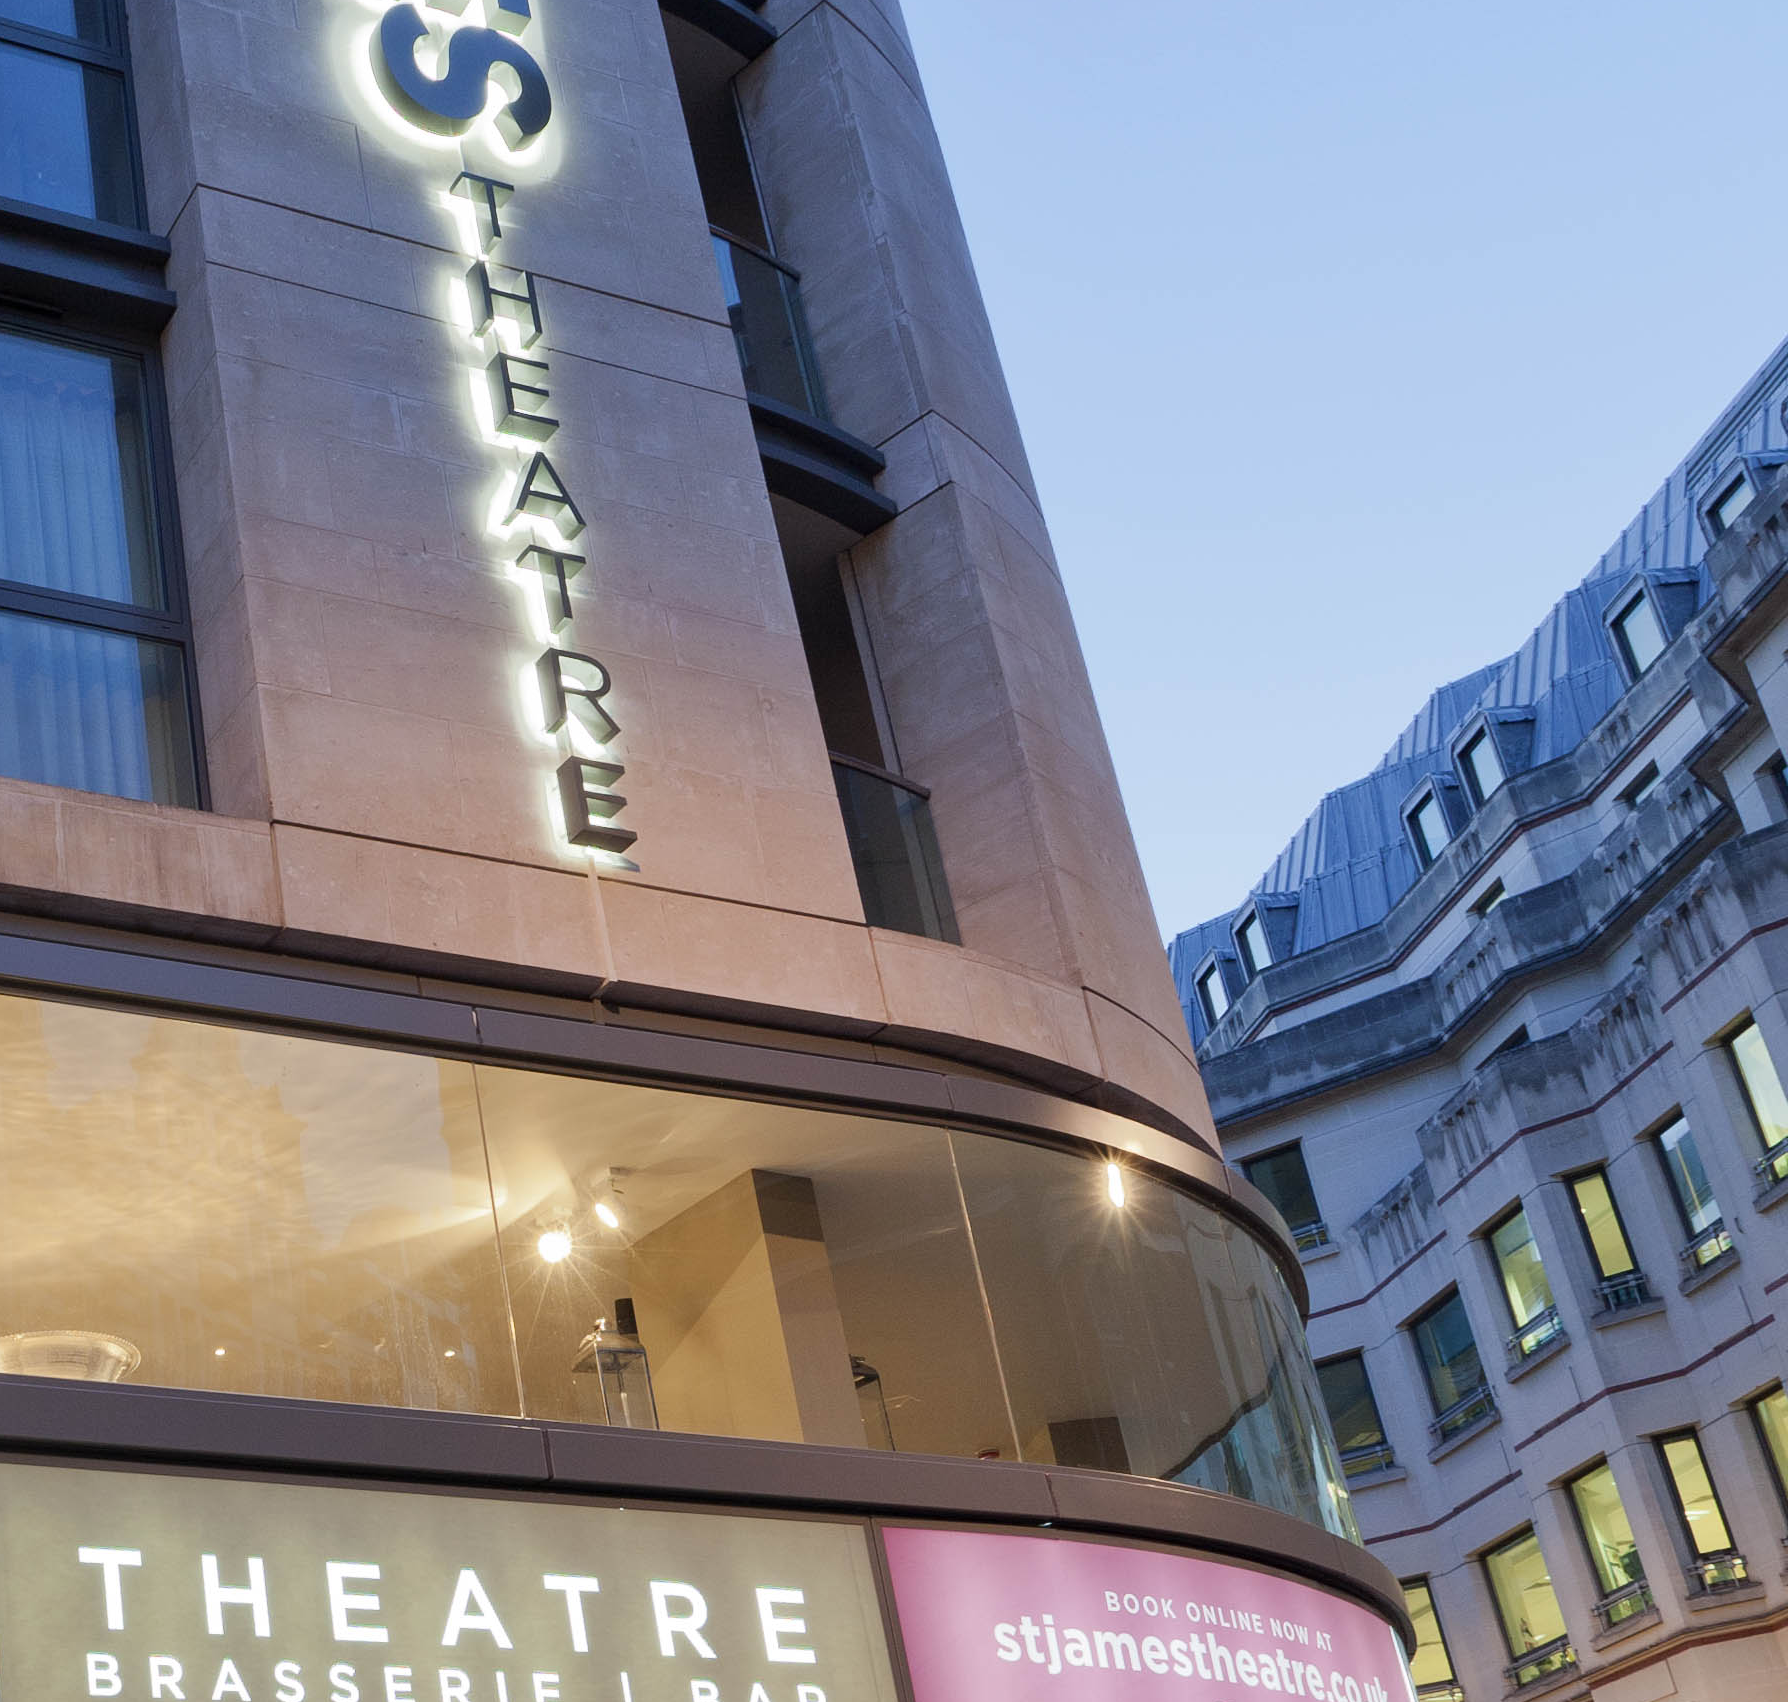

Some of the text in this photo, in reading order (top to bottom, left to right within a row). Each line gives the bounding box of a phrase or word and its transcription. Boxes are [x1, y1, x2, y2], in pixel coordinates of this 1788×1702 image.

[449, 171, 638, 854] THEATRE
[77, 1545, 818, 1665] THEATRE
[1104, 1590, 1333, 1653] BOOK ONLINE NOW AT
